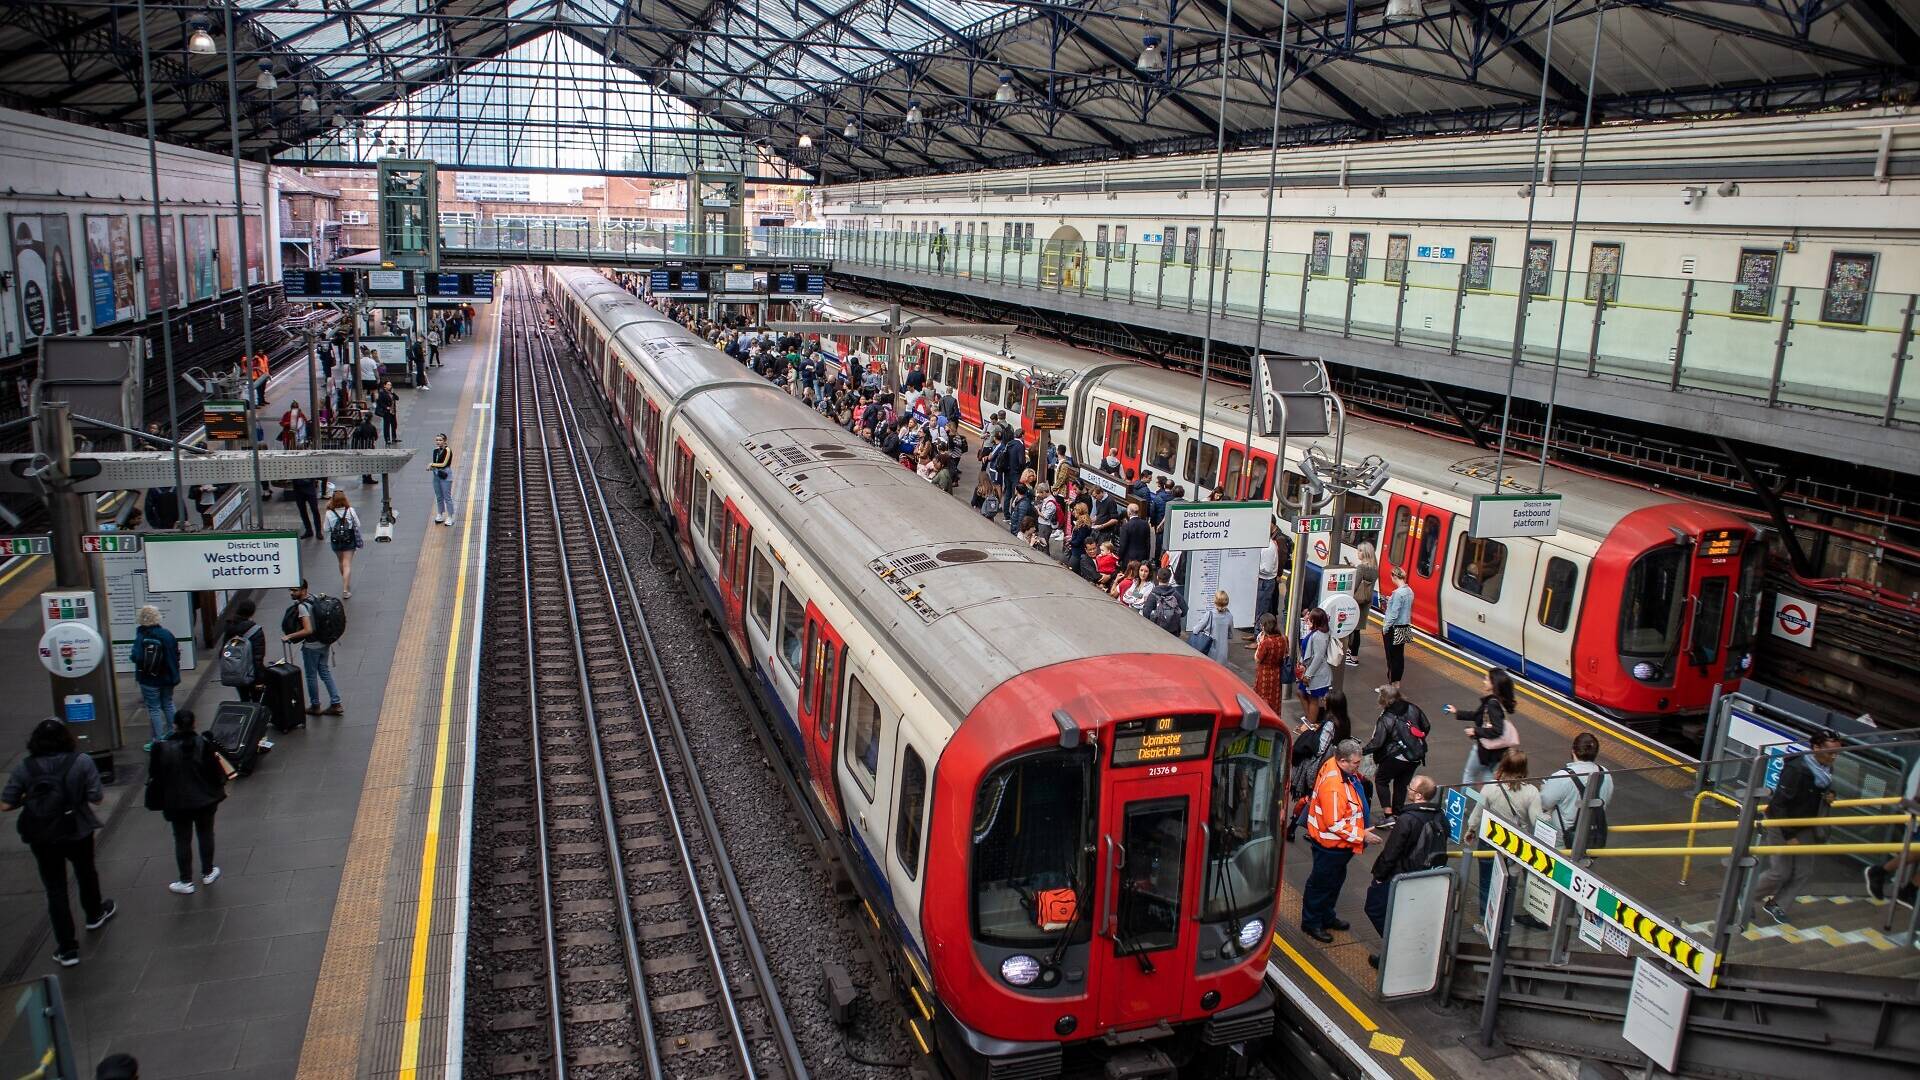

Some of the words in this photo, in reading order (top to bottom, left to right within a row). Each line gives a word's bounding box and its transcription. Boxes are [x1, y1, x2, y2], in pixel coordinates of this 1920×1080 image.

[1513, 509, 1550, 517] Eastbound
[1183, 519, 1230, 529] Eastbound
[1513, 519, 1544, 528] platform
[1182, 531, 1220, 541] platform
[1224, 530, 1228, 538] 2
[263, 541, 279, 549] line
[204, 551, 280, 563] Westbound
[212, 565, 269, 579] platform
[273, 565, 281, 574] 3
[1160, 719, 1171, 729] 011
[1142, 734, 1181, 747] Upminster
[1139, 747, 1166, 759] District
[1149, 767, 1170, 776] 21376
[1587, 883, 1597, 900] 7
